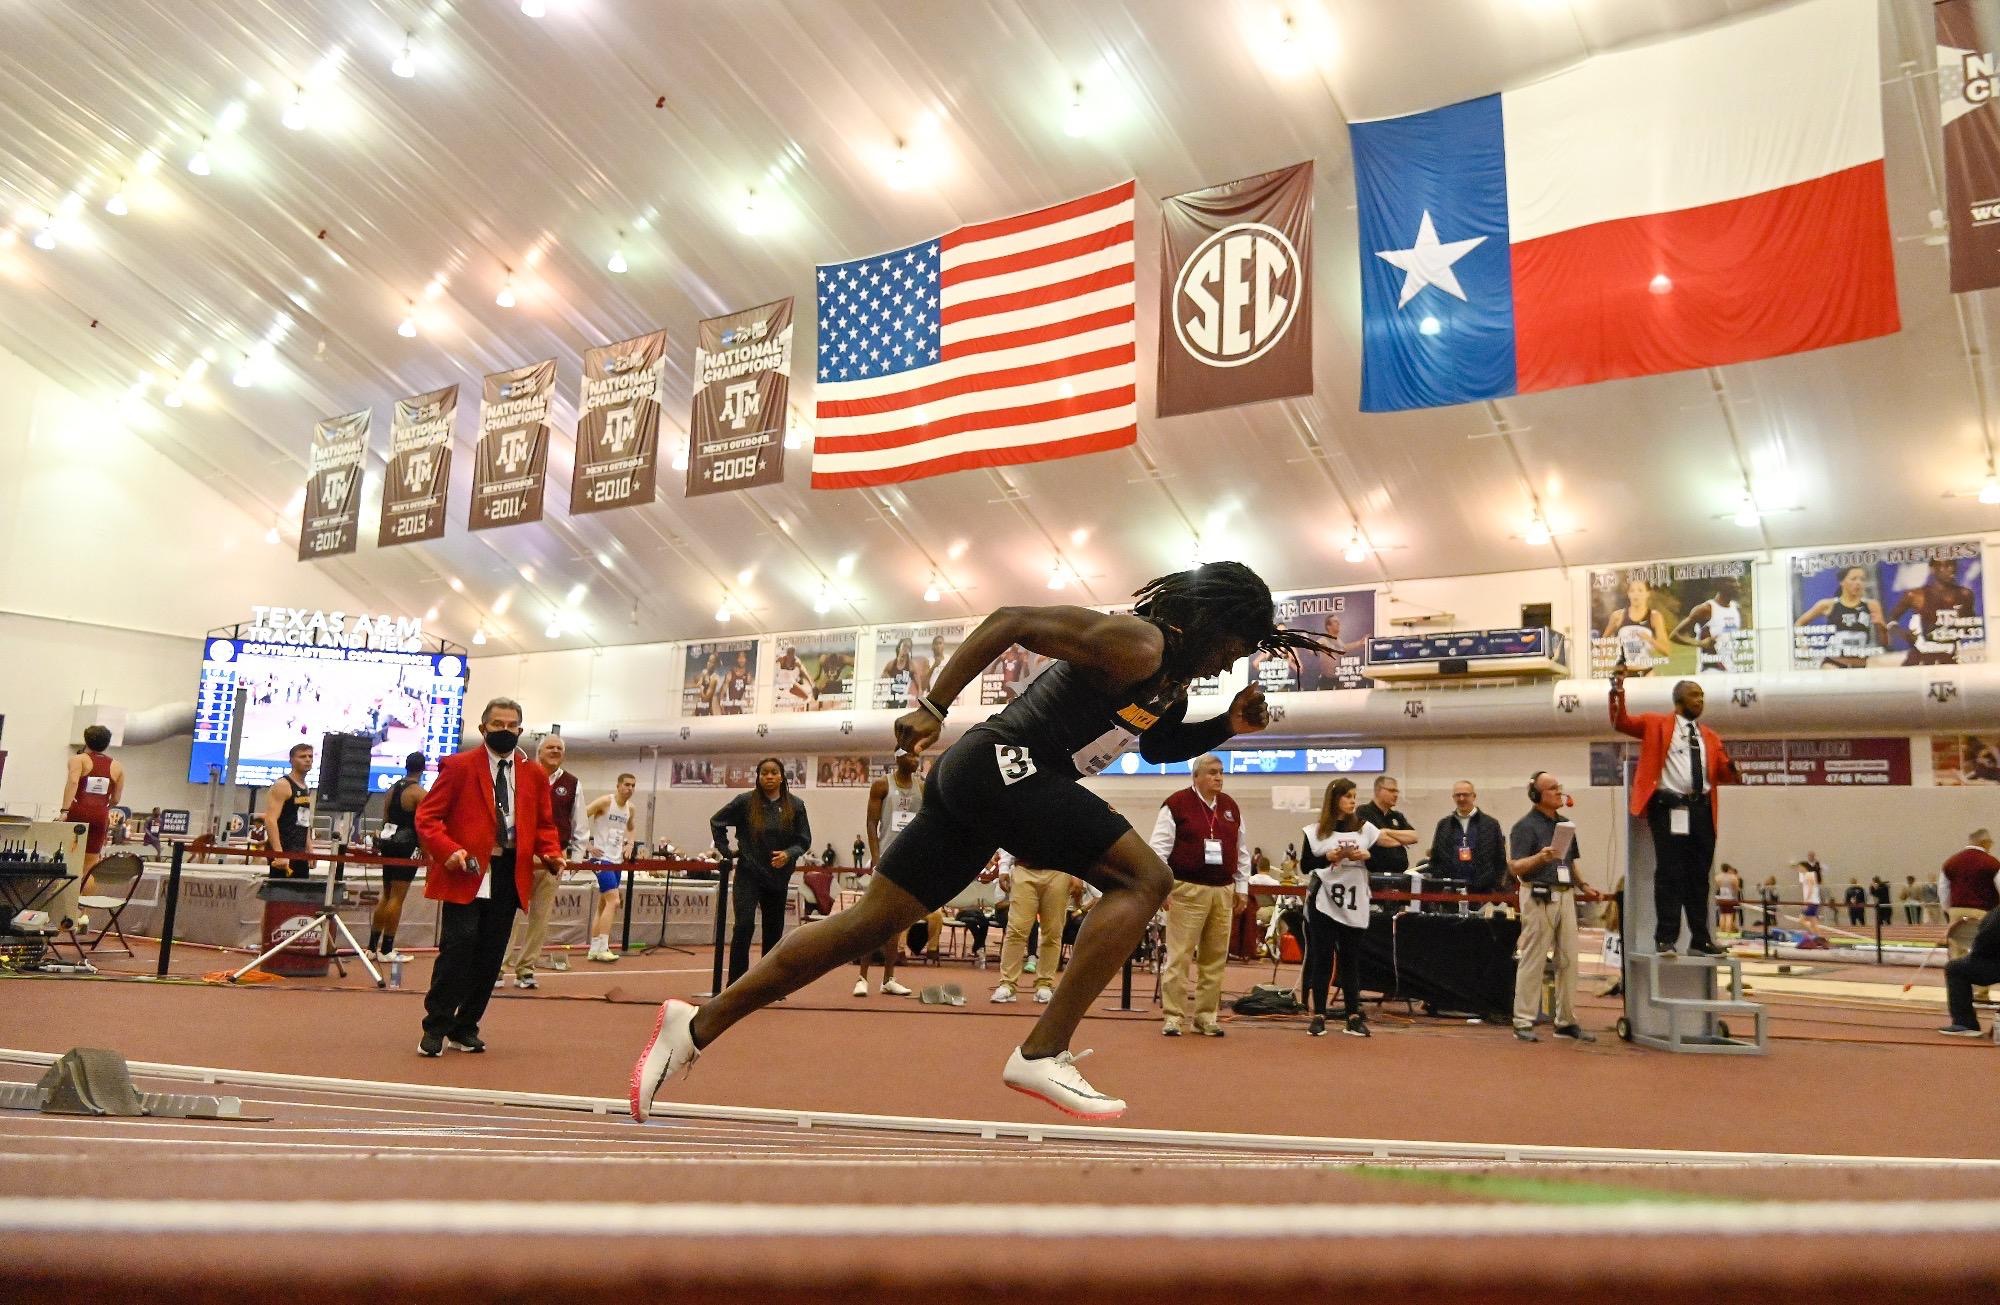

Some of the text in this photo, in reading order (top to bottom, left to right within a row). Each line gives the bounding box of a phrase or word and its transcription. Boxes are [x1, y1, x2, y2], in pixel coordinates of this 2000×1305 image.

[1184, 235, 1288, 355] SEC
[704, 338, 783, 369] NATIONAL
[703, 354, 782, 384] CHAMPIONS
[589, 368, 656, 396] NATIONAL
[587, 381, 656, 409] CHAMPIONS
[487, 395, 546, 419] NATIONAL
[396, 418, 449, 441] NATIONAL
[485, 408, 545, 432] CHAMPIONS
[703, 443, 729, 454] MEN'S
[729, 434, 770, 451] OUTDOOR
[712, 456, 757, 483] 2009
[594, 477, 631, 503] 2010
[491, 498, 520, 520] 2011
[397, 514, 426, 537] 2013
[315, 529, 342, 552] 2017
[1886, 543, 1980, 565] METERS
[1674, 561, 1746, 580] METERS
[1300, 597, 1345, 616] MILE
[251, 605, 423, 639] TEXAS A&M
[247, 626, 423, 654] TRACK AND FIELD
[1000, 745, 1029, 779] 3
[1789, 760, 1816, 771] 2021
[183, 882, 215, 897] TEXAS
[554, 894, 582, 907] A&M
[638, 893, 710, 908] TEXAS A&M
[1331, 884, 1357, 910] 81
